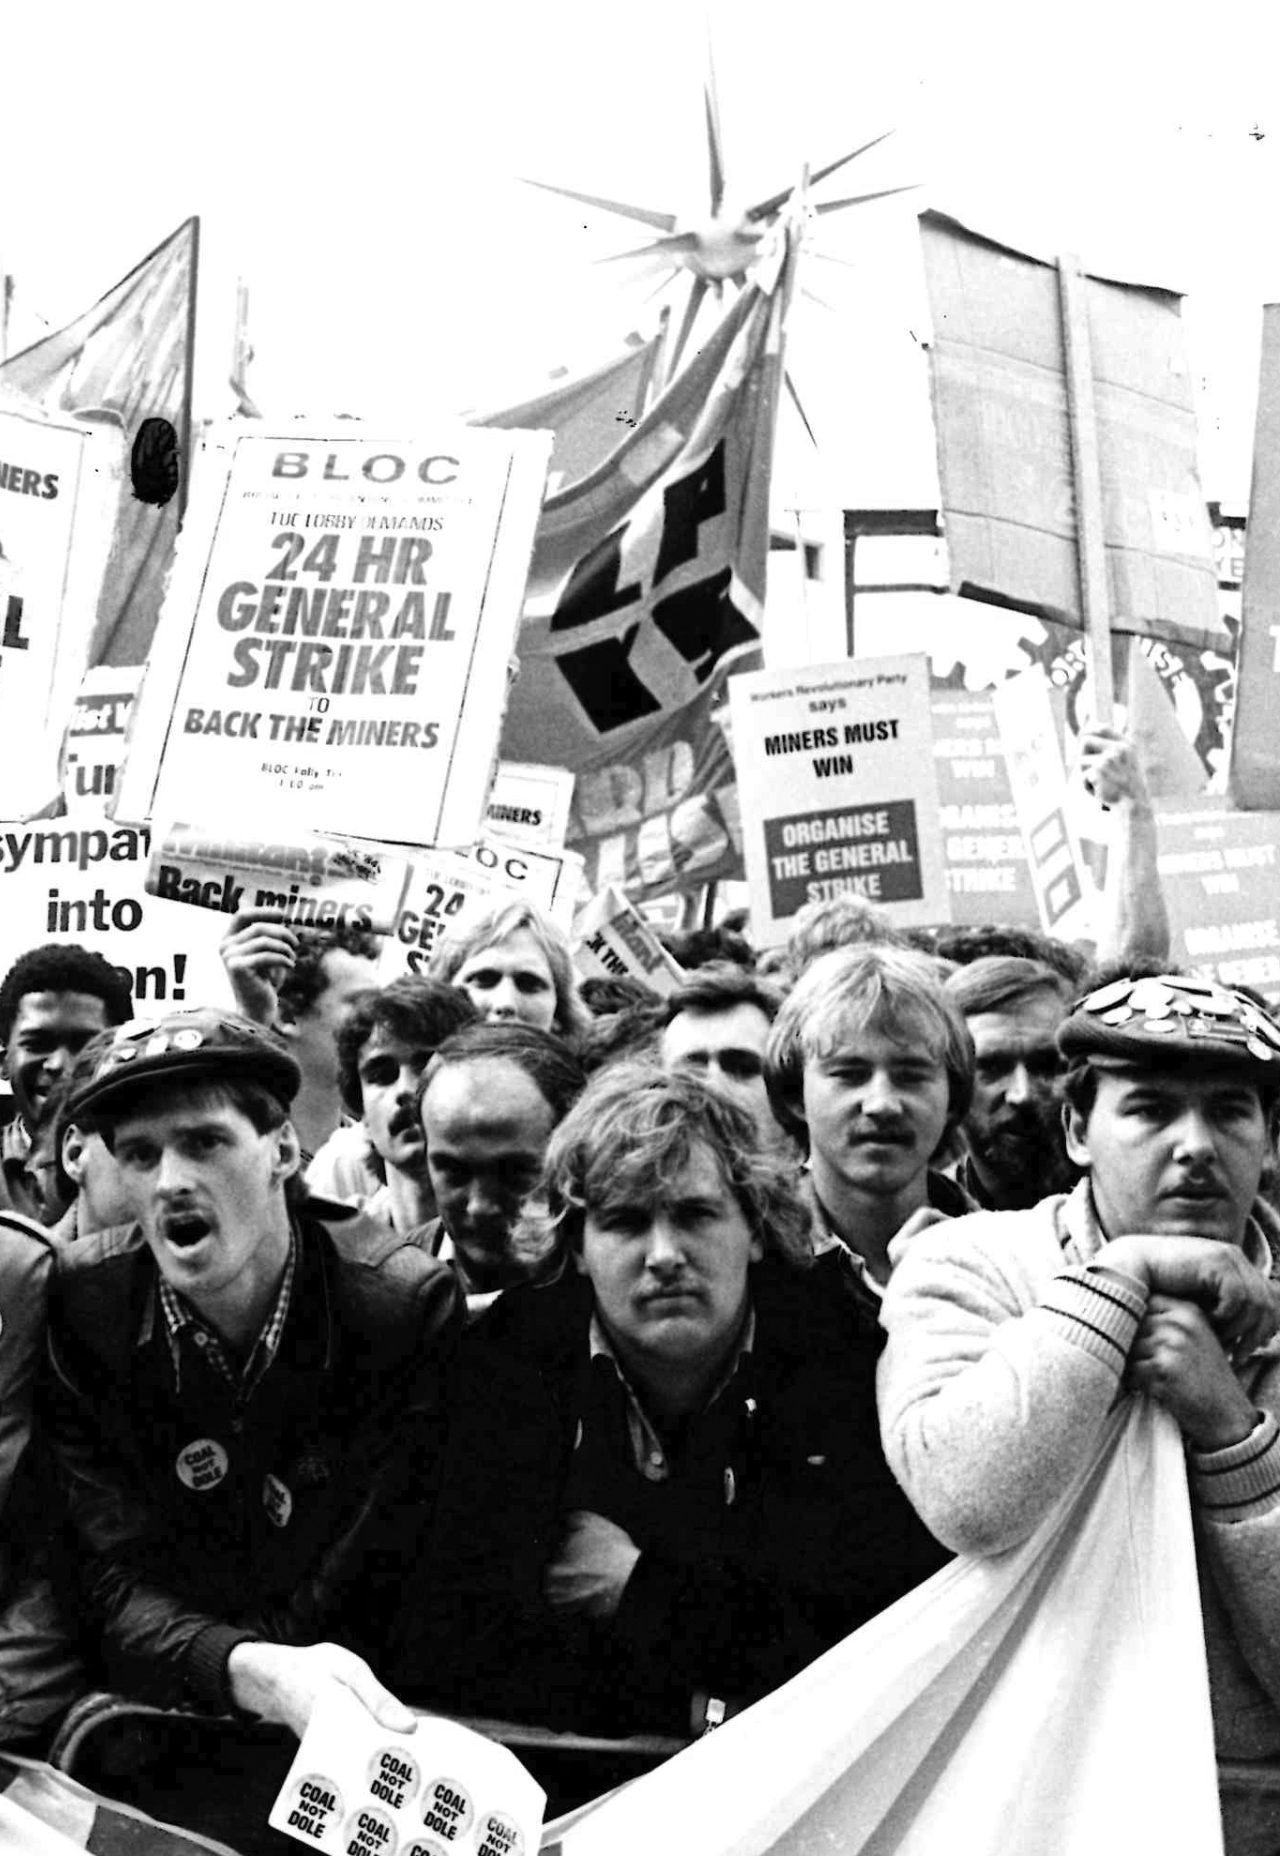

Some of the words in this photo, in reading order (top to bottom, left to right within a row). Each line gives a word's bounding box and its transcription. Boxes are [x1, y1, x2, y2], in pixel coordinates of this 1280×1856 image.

[271, 452, 460, 484] BLOC
[264, 532, 341, 583] 24
[352, 535, 434, 586] HR
[217, 581, 457, 642] GENERAL
[227, 637, 425, 696] STRIKE
[750, 689, 793, 702] Workers
[795, 677, 873, 696] Revolutionary
[876, 673, 908, 685] Party
[309, 697, 330, 714] TO
[808, 697, 847, 714] says
[183, 708, 262, 740] BACK
[269, 713, 324, 744] THE
[325, 719, 440, 750] MINERS
[764, 726, 839, 756] MINERS
[844, 719, 900, 745] MUST
[812, 754, 854, 779] WIN
[782, 811, 891, 848] ORGANISE
[772, 852, 811, 880] THE
[814, 839, 914, 873] GENERAL
[157, 865, 244, 914] Back
[255, 884, 374, 932] miners
[806, 873, 882, 903] STRIKE
[46, 889, 144, 933] into
[184, 1445, 217, 1466] COAL
[379, 1769, 407, 1790] NOT
[380, 1753, 413, 1783] COAL
[298, 1799, 328, 1820] NOT
[299, 1782, 337, 1813] COAL
[370, 1779, 404, 1810] DOLE
[433, 1784, 467, 1815] COAL
[287, 1810, 326, 1839] DOLE
[423, 1811, 457, 1841] DOLE
[433, 1801, 459, 1822] NOT
[356, 1830, 383, 1850] NOT
[357, 1813, 390, 1843] COAL
[487, 1817, 518, 1846] COAL
[486, 1833, 511, 1854] NOT
